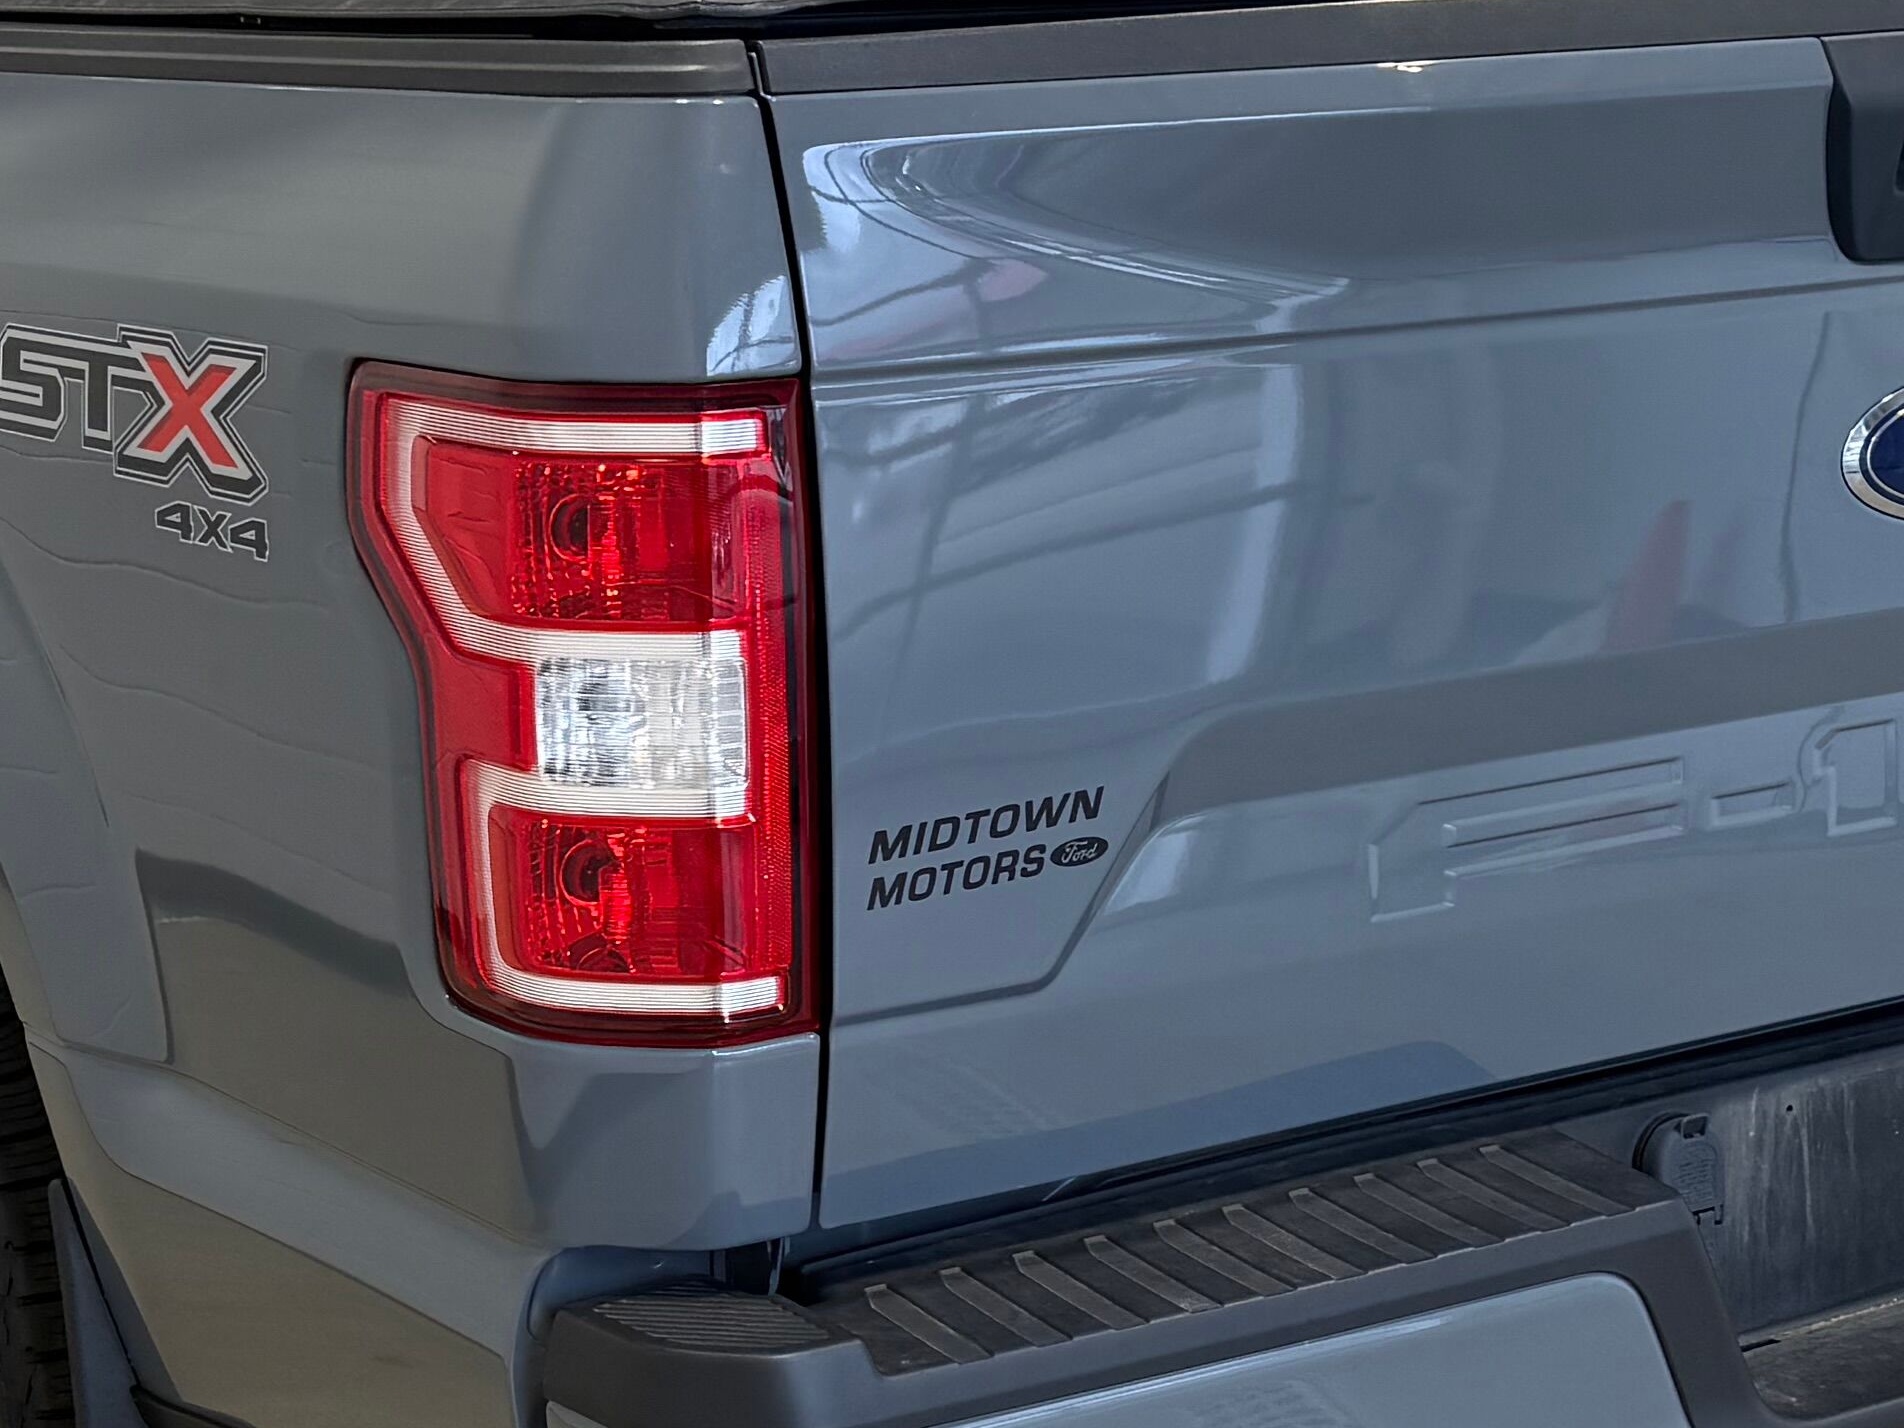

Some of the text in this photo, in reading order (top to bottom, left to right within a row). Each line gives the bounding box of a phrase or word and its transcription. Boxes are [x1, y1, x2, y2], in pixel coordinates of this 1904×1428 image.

[868, 785, 1105, 865] MIDTOWN
[866, 840, 1100, 911] MOTORS Ford
